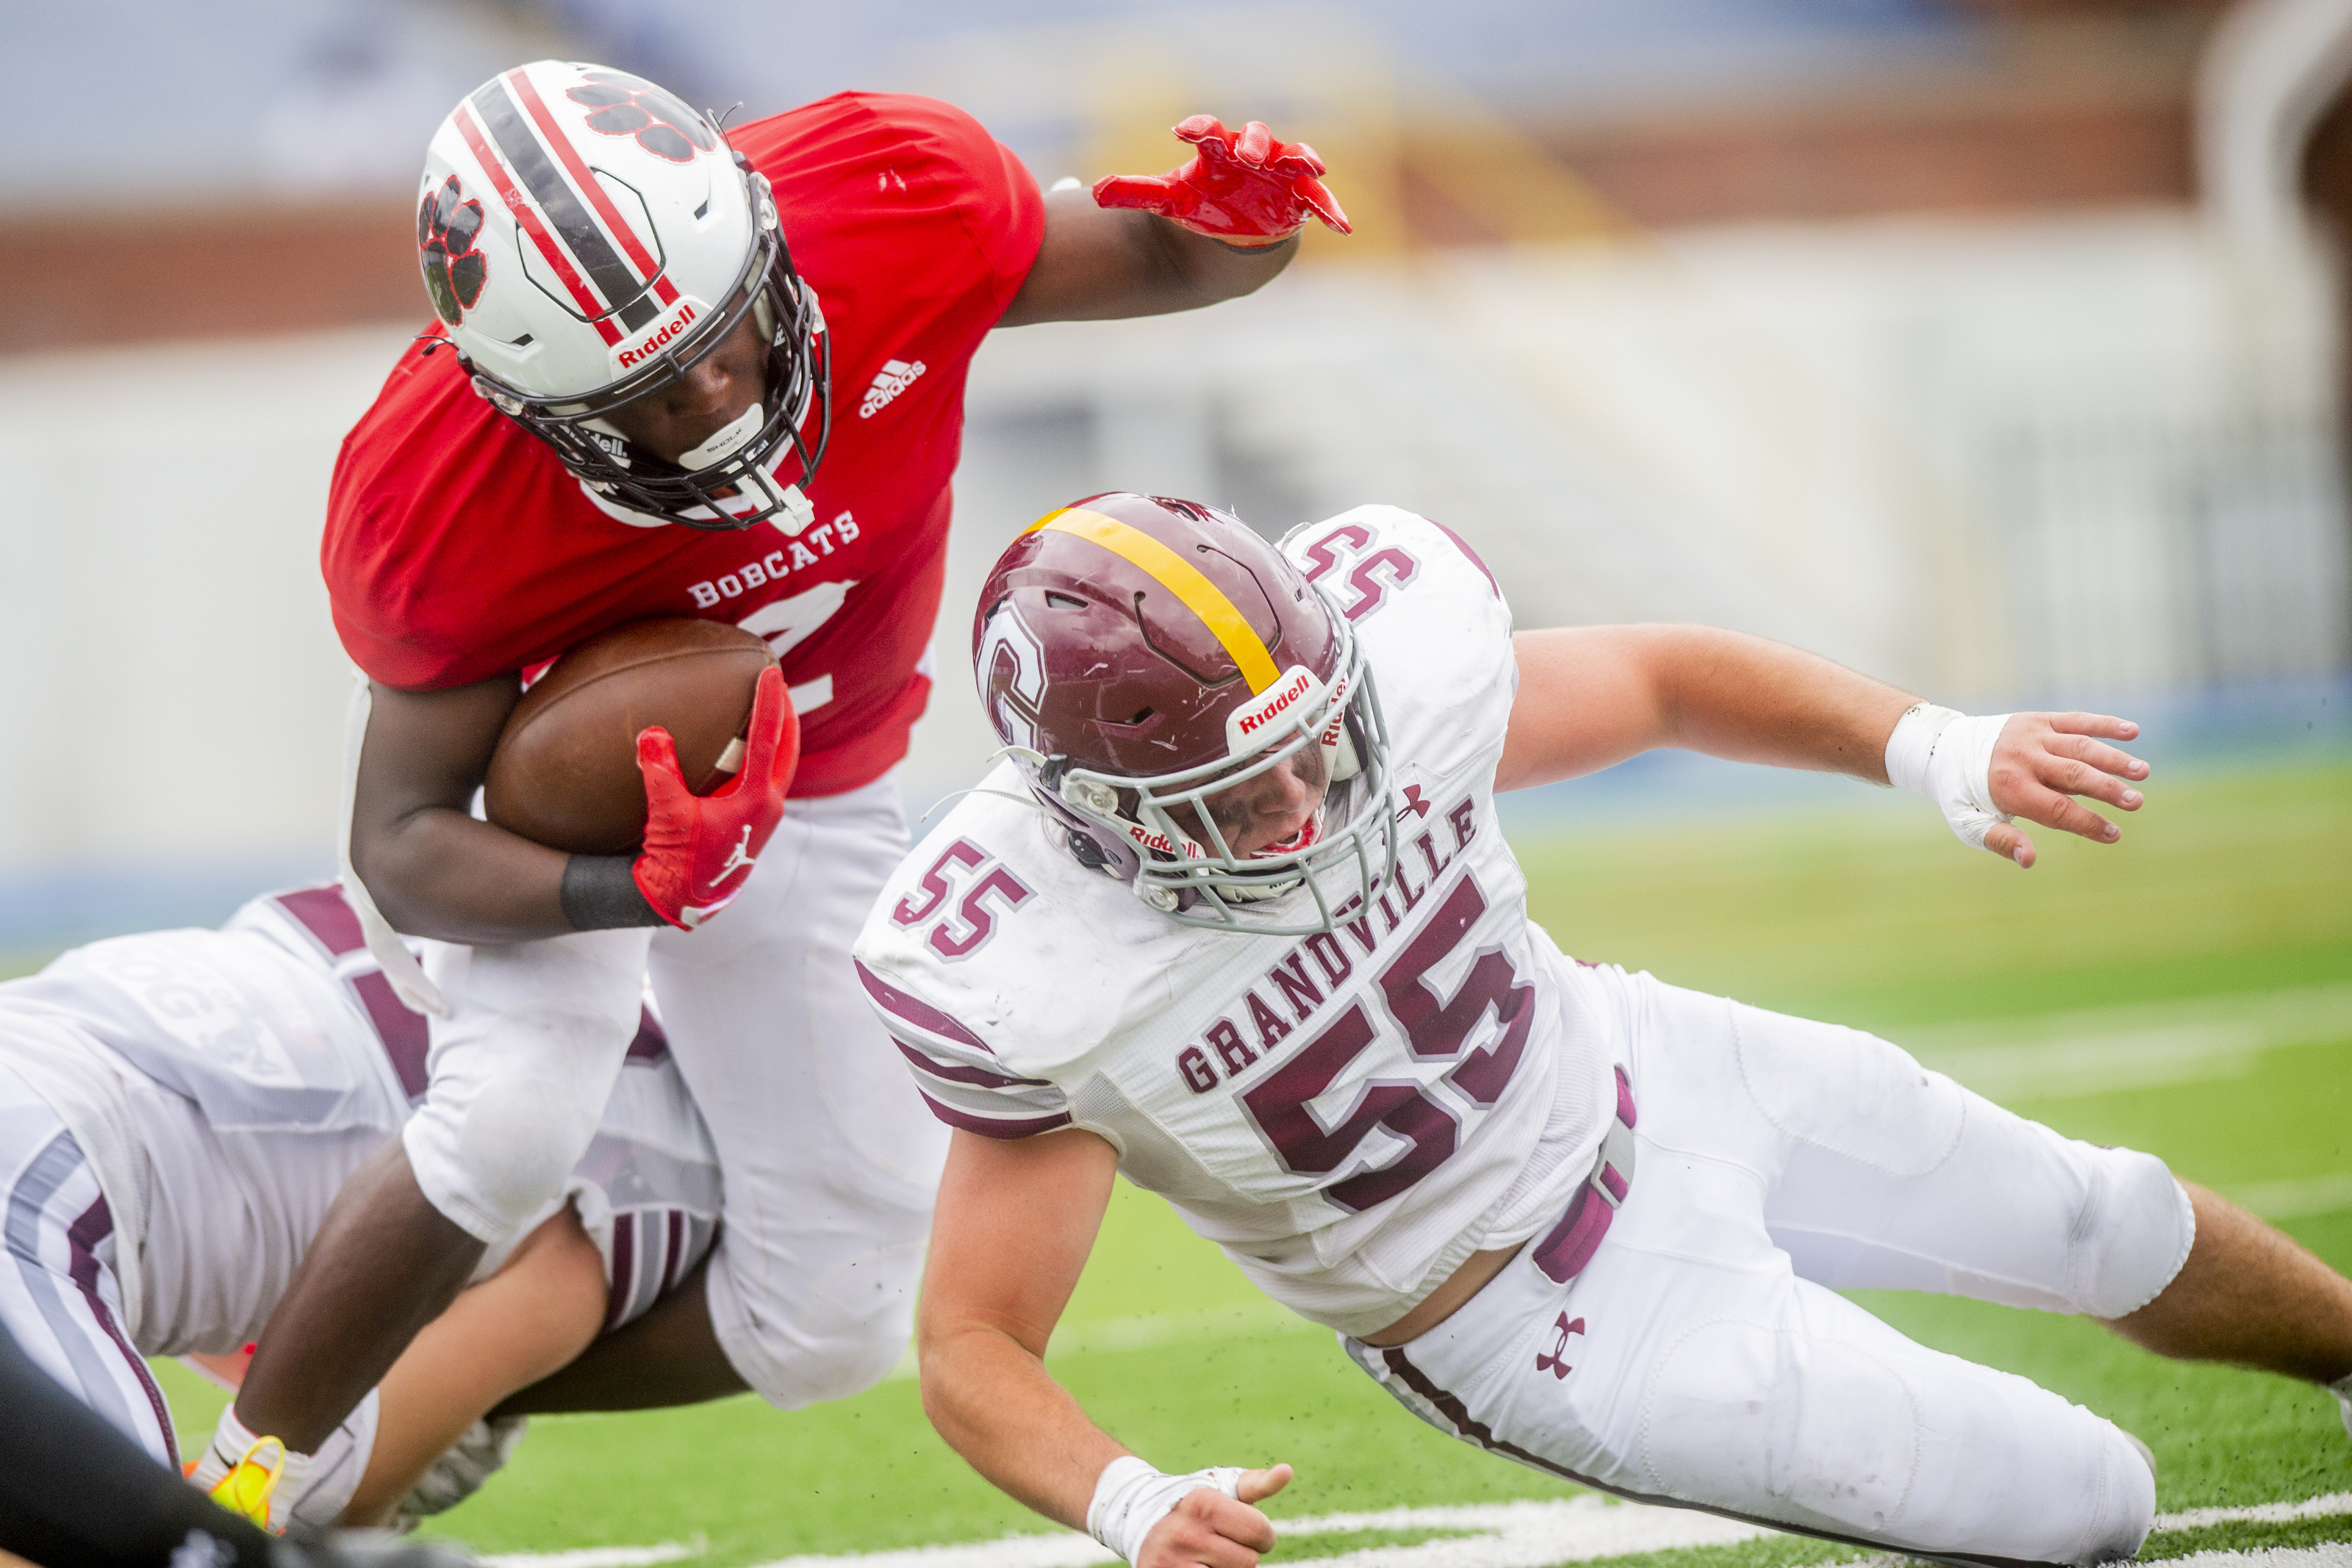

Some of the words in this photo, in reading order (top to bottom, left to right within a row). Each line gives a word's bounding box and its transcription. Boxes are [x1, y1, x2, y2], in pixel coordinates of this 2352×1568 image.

[618, 304, 697, 369] Riddell
[858, 360, 927, 420] adidas
[687, 510, 860, 609] BOBCATS
[1239, 674, 1310, 736] Riddell
[888, 835, 1039, 965] 55
[1177, 794, 1478, 1095] GRANDVILLE
[1232, 863, 1536, 1215] 55
